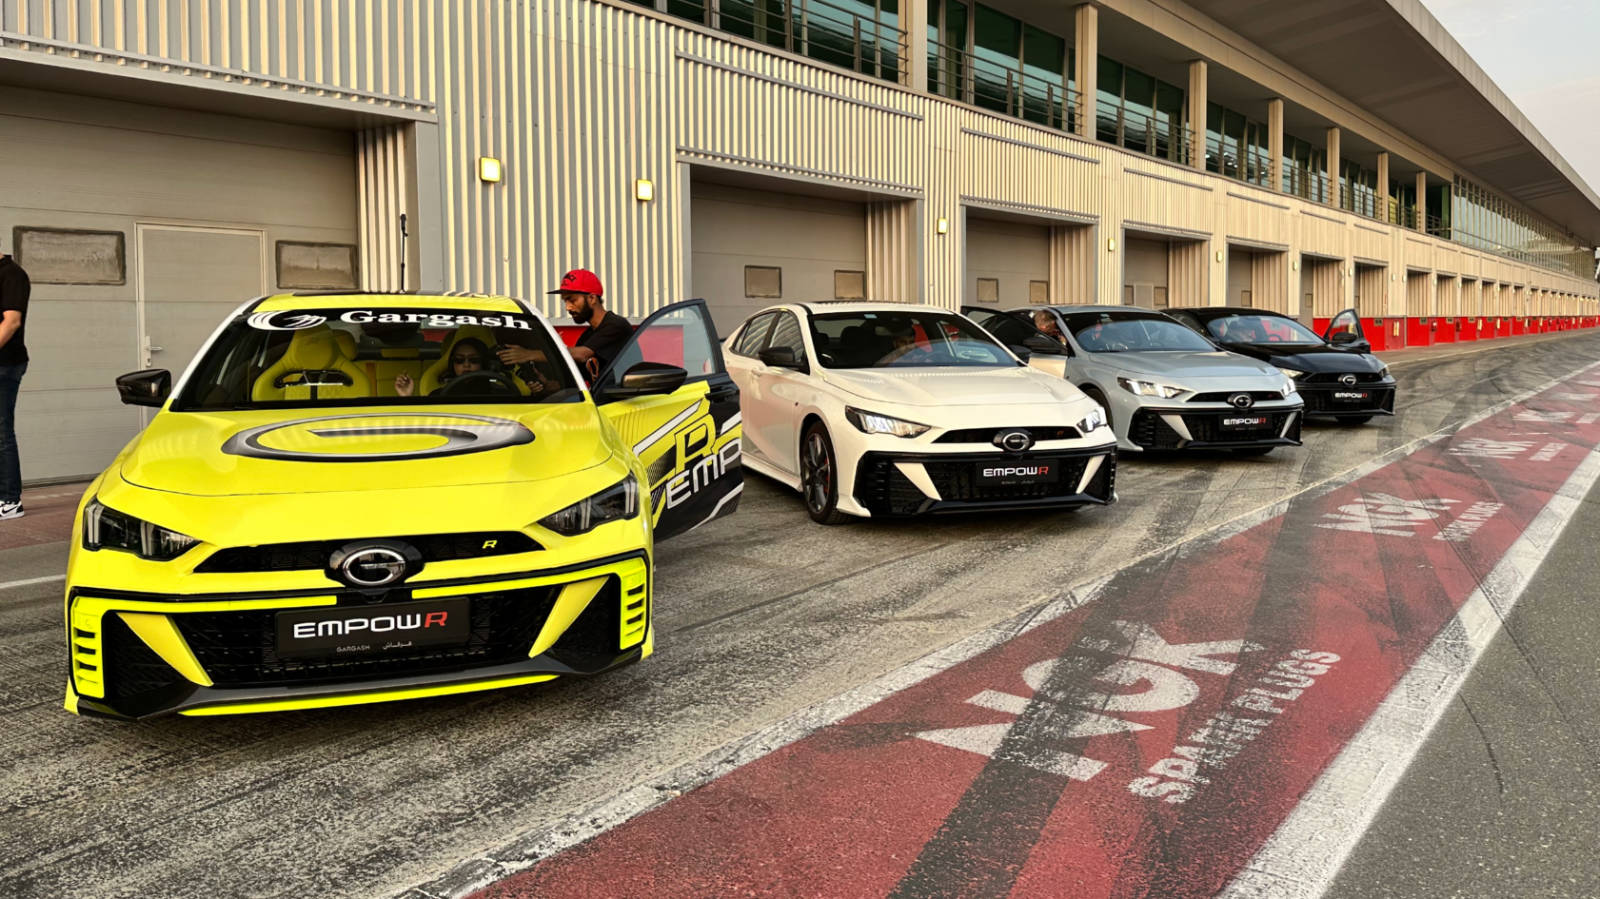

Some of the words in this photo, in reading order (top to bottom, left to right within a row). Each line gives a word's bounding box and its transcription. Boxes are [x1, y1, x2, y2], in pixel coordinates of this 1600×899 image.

[340, 310, 532, 331] Gargash
[1223, 417, 1267, 426] EMPOWR
[983, 466, 1049, 477] EMPOWR
[482, 540, 497, 549] R
[293, 611, 448, 639] EMPOWR
[1231, 648, 1341, 715] PLUGS
[913, 620, 1266, 782] NGK
